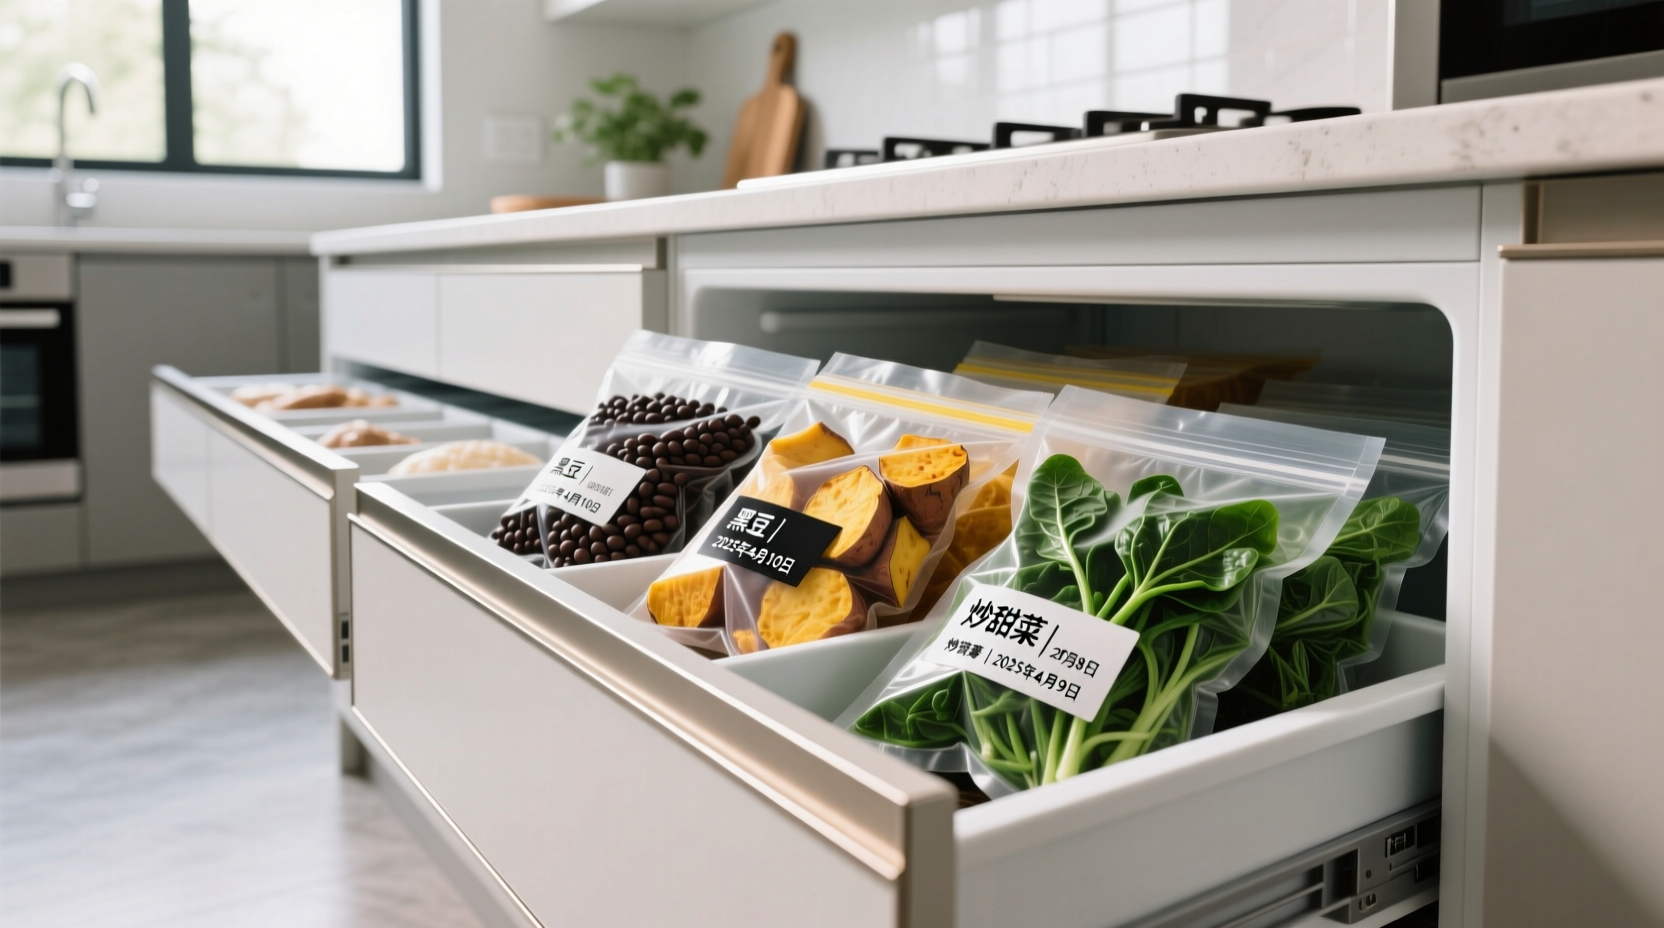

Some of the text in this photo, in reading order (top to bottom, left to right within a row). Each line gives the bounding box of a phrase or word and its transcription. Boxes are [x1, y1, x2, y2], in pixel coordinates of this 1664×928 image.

[726, 507, 776, 538] 黑豆
[960, 598, 1049, 647] 炒甜菜
[992, 653, 1082, 702] 2025年4月9日
